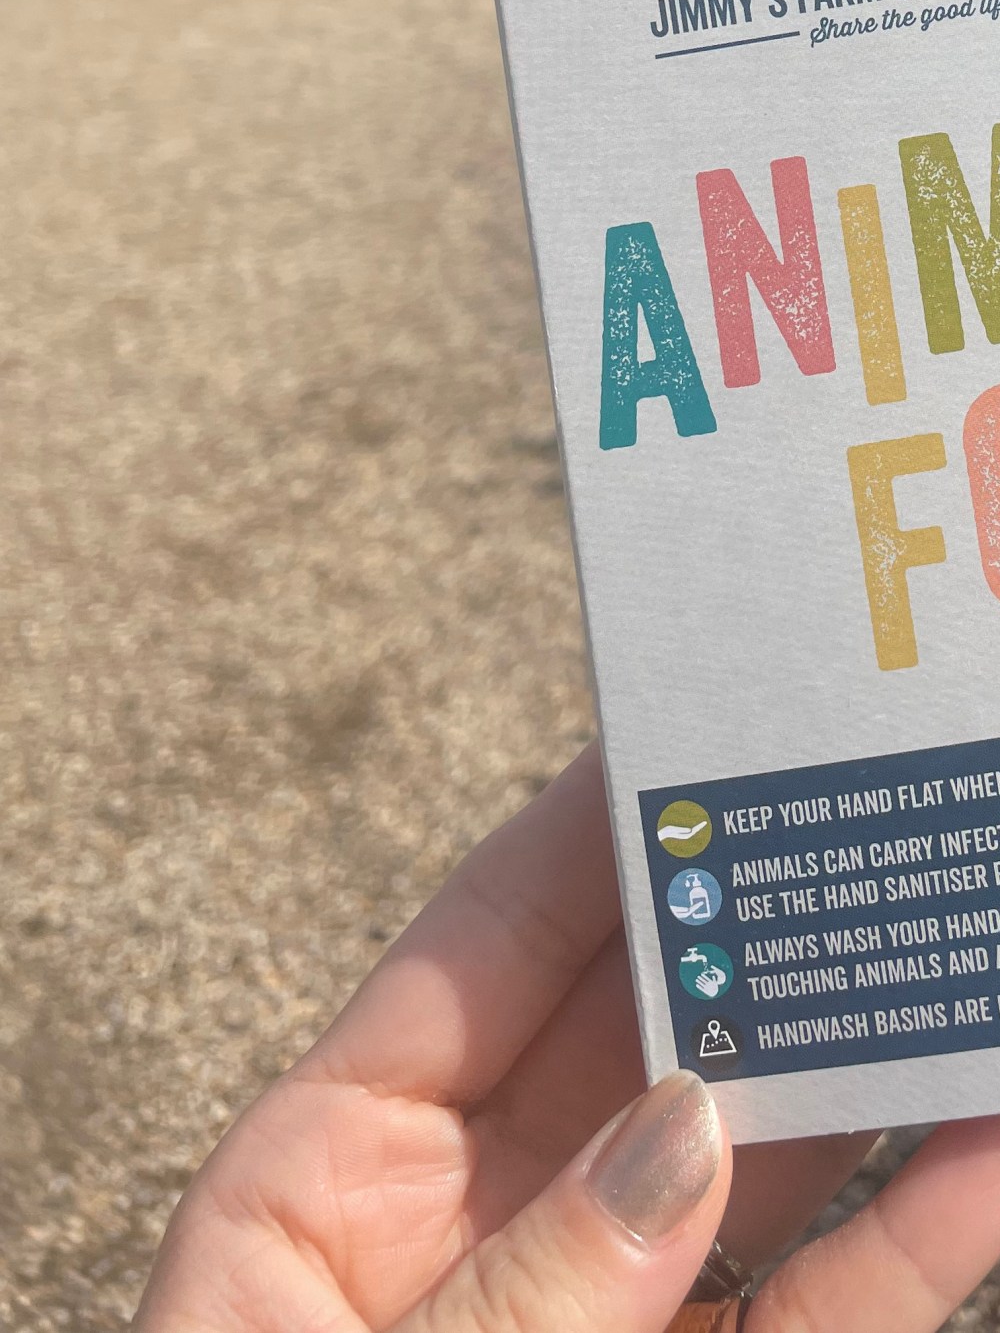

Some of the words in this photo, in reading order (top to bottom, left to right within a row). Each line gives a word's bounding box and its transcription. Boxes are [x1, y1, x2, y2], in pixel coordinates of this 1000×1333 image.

[811, 17, 878, 48] Share
[882, 9, 916, 30] the
[724, 806, 772, 835] KEEP
[778, 798, 832, 826] YOUR
[837, 789, 892, 818] HAND
[898, 780, 943, 810] FLAT
[733, 852, 818, 886] ANIMALS
[824, 846, 864, 874] CAN
[869, 835, 932, 867] CARRY
[736, 894, 775, 921] USE
[779, 888, 819, 915] THE
[824, 880, 878, 909] HAND
[885, 864, 988, 901] SANITISER
[746, 935, 819, 966] ALWAYS
[823, 926, 881, 955] WASH
[886, 918, 941, 947] YOUR
[748, 966, 848, 1000] TOUCHING
[854, 954, 942, 987] ANIMALS
[950, 947, 989, 975] AND
[758, 1013, 869, 1049] HANDWASH
[875, 1003, 947, 1034] BASINS
[955, 997, 992, 1025] ARE
